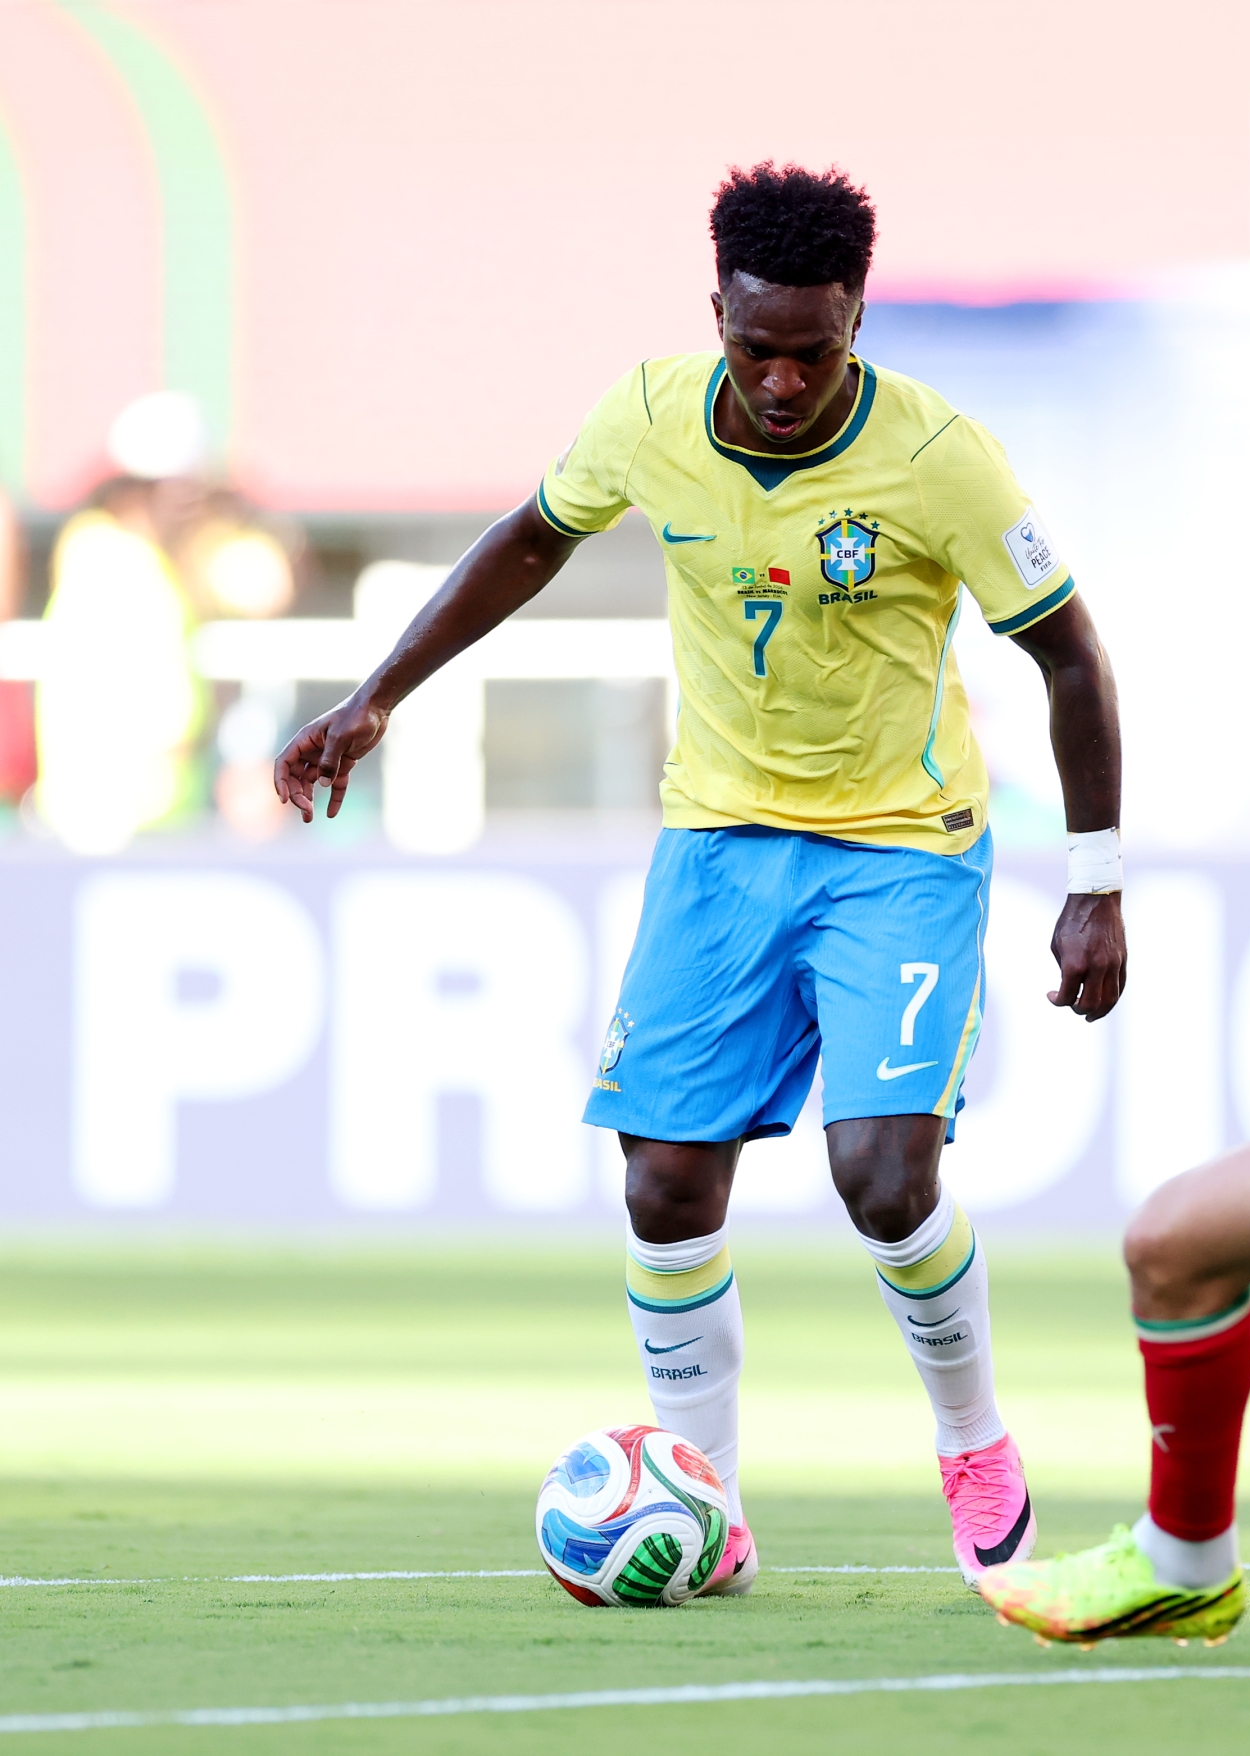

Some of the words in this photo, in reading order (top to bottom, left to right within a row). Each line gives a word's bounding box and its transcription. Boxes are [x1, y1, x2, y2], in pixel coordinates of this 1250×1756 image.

[836, 549, 859, 559] CBF
[1031, 546, 1051, 569] PEACE
[1040, 560, 1052, 572] FIFA
[818, 590, 878, 605] BRASIL
[744, 600, 784, 677] 7
[900, 962, 939, 1046] 7
[911, 1331, 969, 1346] BRASIL
[650, 1364, 708, 1380] BRASIL
